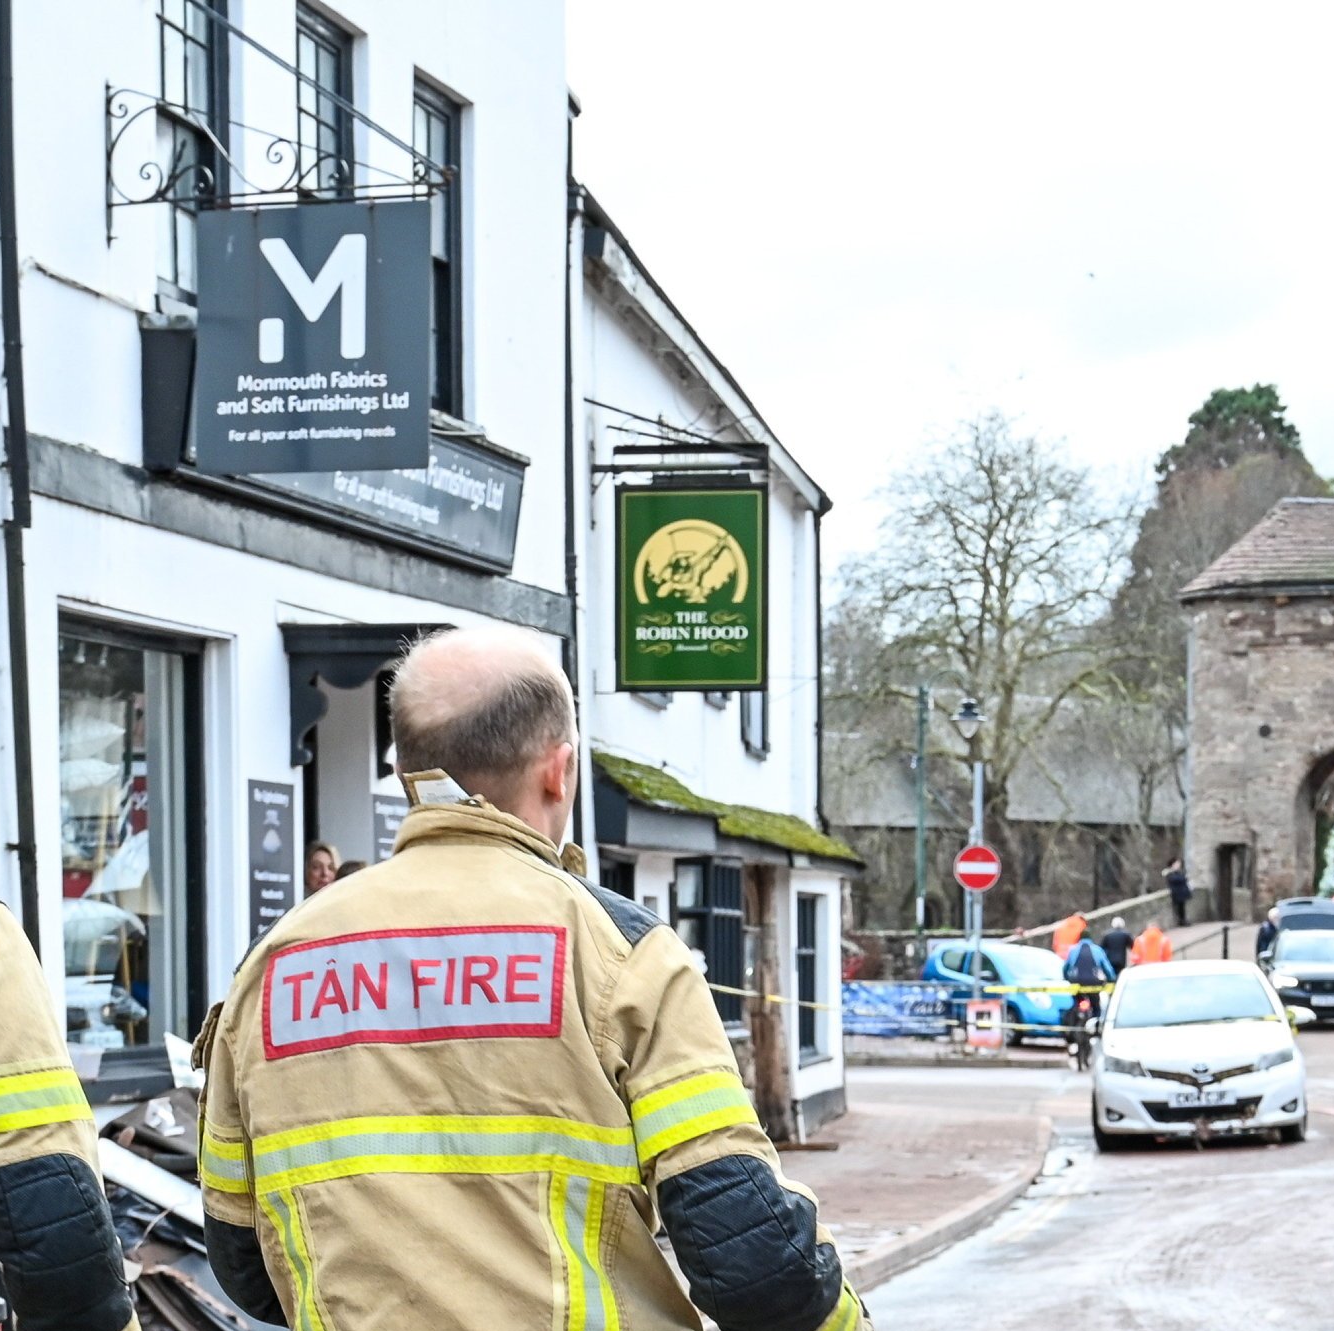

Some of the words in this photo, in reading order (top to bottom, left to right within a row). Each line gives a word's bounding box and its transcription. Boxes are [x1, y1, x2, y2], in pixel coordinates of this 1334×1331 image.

[237, 372, 327, 392] Monmouth
[330, 370, 387, 389] Fabrics
[217, 397, 248, 415] and
[251, 396, 285, 414] Soft
[287, 393, 380, 415] Furnishings
[382, 391, 410, 410] Ltd
[228, 428, 246, 442] For
[247, 429, 261, 441] all
[261, 429, 286, 444] your
[287, 427, 308, 440] soft
[309, 425, 363, 441] furnishing
[363, 424, 396, 438] needs
[674, 611, 708, 624] THE
[635, 626, 690, 640] ROBIN
[693, 626, 749, 640] HOOD
[282, 958, 389, 1021] TÂN
[410, 954, 543, 1009] FIRE
